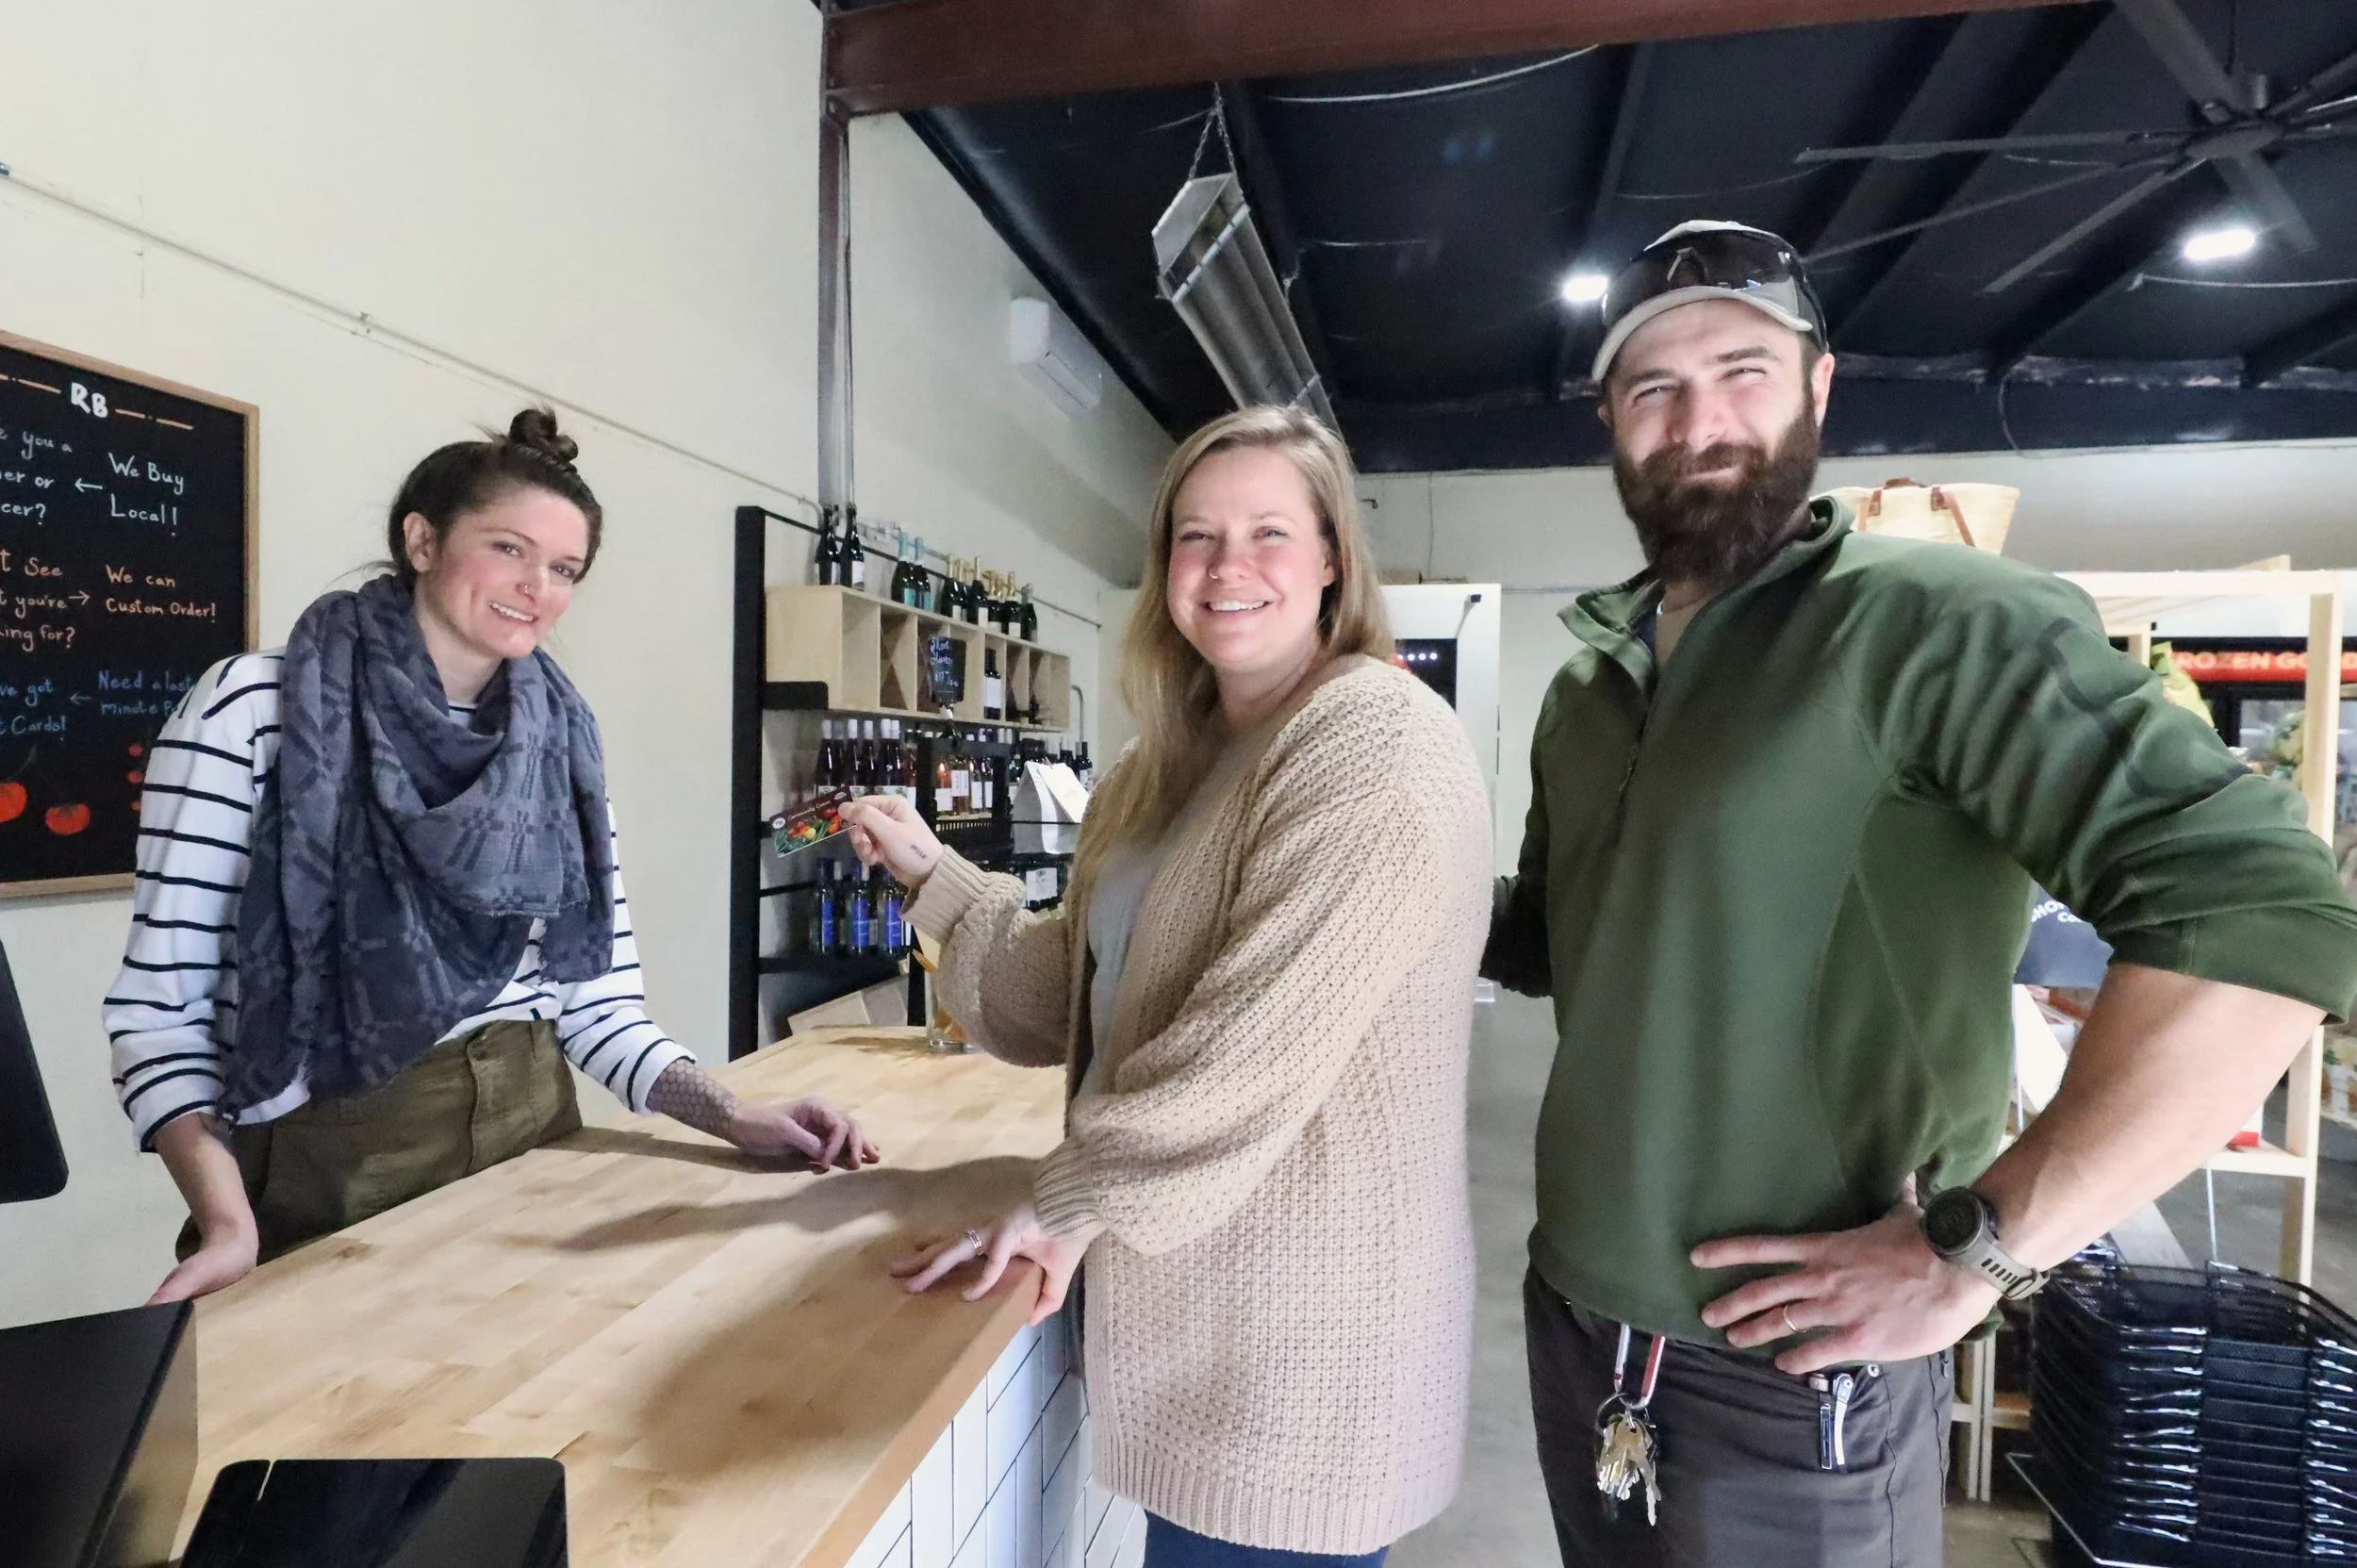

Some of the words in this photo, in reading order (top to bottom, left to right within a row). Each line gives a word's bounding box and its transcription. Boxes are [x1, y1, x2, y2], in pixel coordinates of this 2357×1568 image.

[71, 382, 108, 418] RB
[21, 431, 54, 460] you
[61, 443, 73, 454] a
[0, 471, 25, 484] er
[35, 476, 55, 488] or
[108, 453, 140, 477] We
[148, 461, 184, 496] Buy
[111, 493, 177, 536] Local!
[25, 557, 62, 577] See
[106, 564, 133, 585] We
[145, 575, 175, 588] can
[106, 598, 163, 615] Custom
[170, 602, 216, 623] Order!
[0, 626, 34, 652] ing
[40, 624, 74, 649] for?
[2172, 651, 2271, 670] ROZEN
[25, 679, 54, 707] got
[98, 669, 142, 691] Need
[10, 715, 67, 742] Cards!
